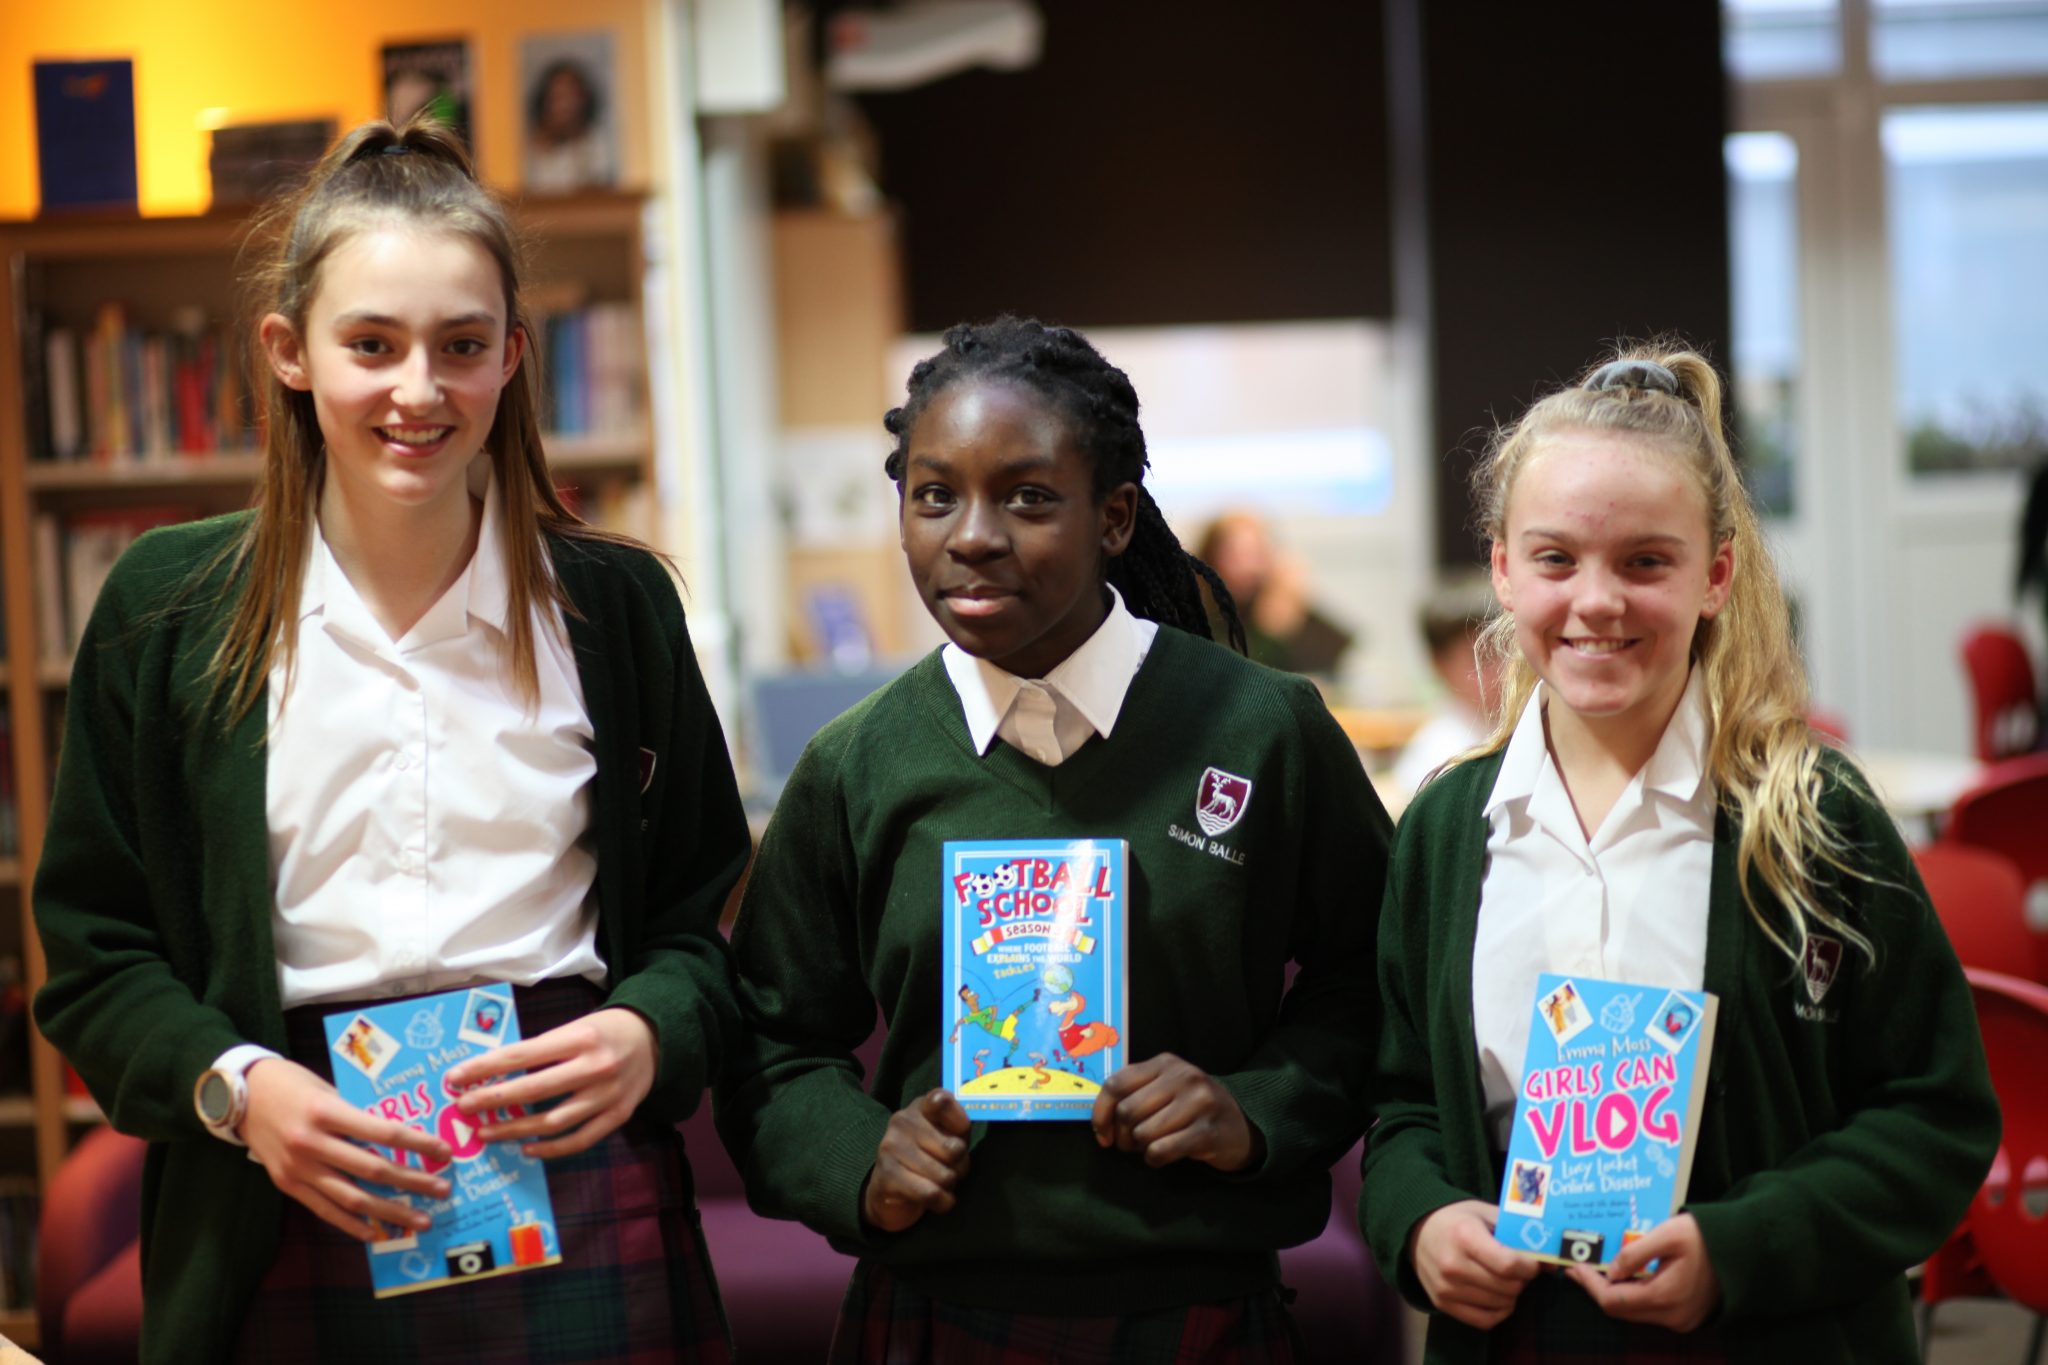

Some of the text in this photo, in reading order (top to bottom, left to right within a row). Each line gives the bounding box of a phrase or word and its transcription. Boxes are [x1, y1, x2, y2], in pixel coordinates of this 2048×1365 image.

[1168, 824, 1245, 866] SIMON BALLE
[952, 858, 1115, 907] FOOTBALL
[976, 889, 1092, 926] SCHOOL
[1557, 1036, 1651, 1063] Emma Moss
[1524, 1053, 1676, 1100] GIRLS CAN
[1525, 1085, 1681, 1158] VLOG
[1550, 1174, 1653, 1196] Online Disaster
[1561, 1160, 1593, 1181] Lucy
